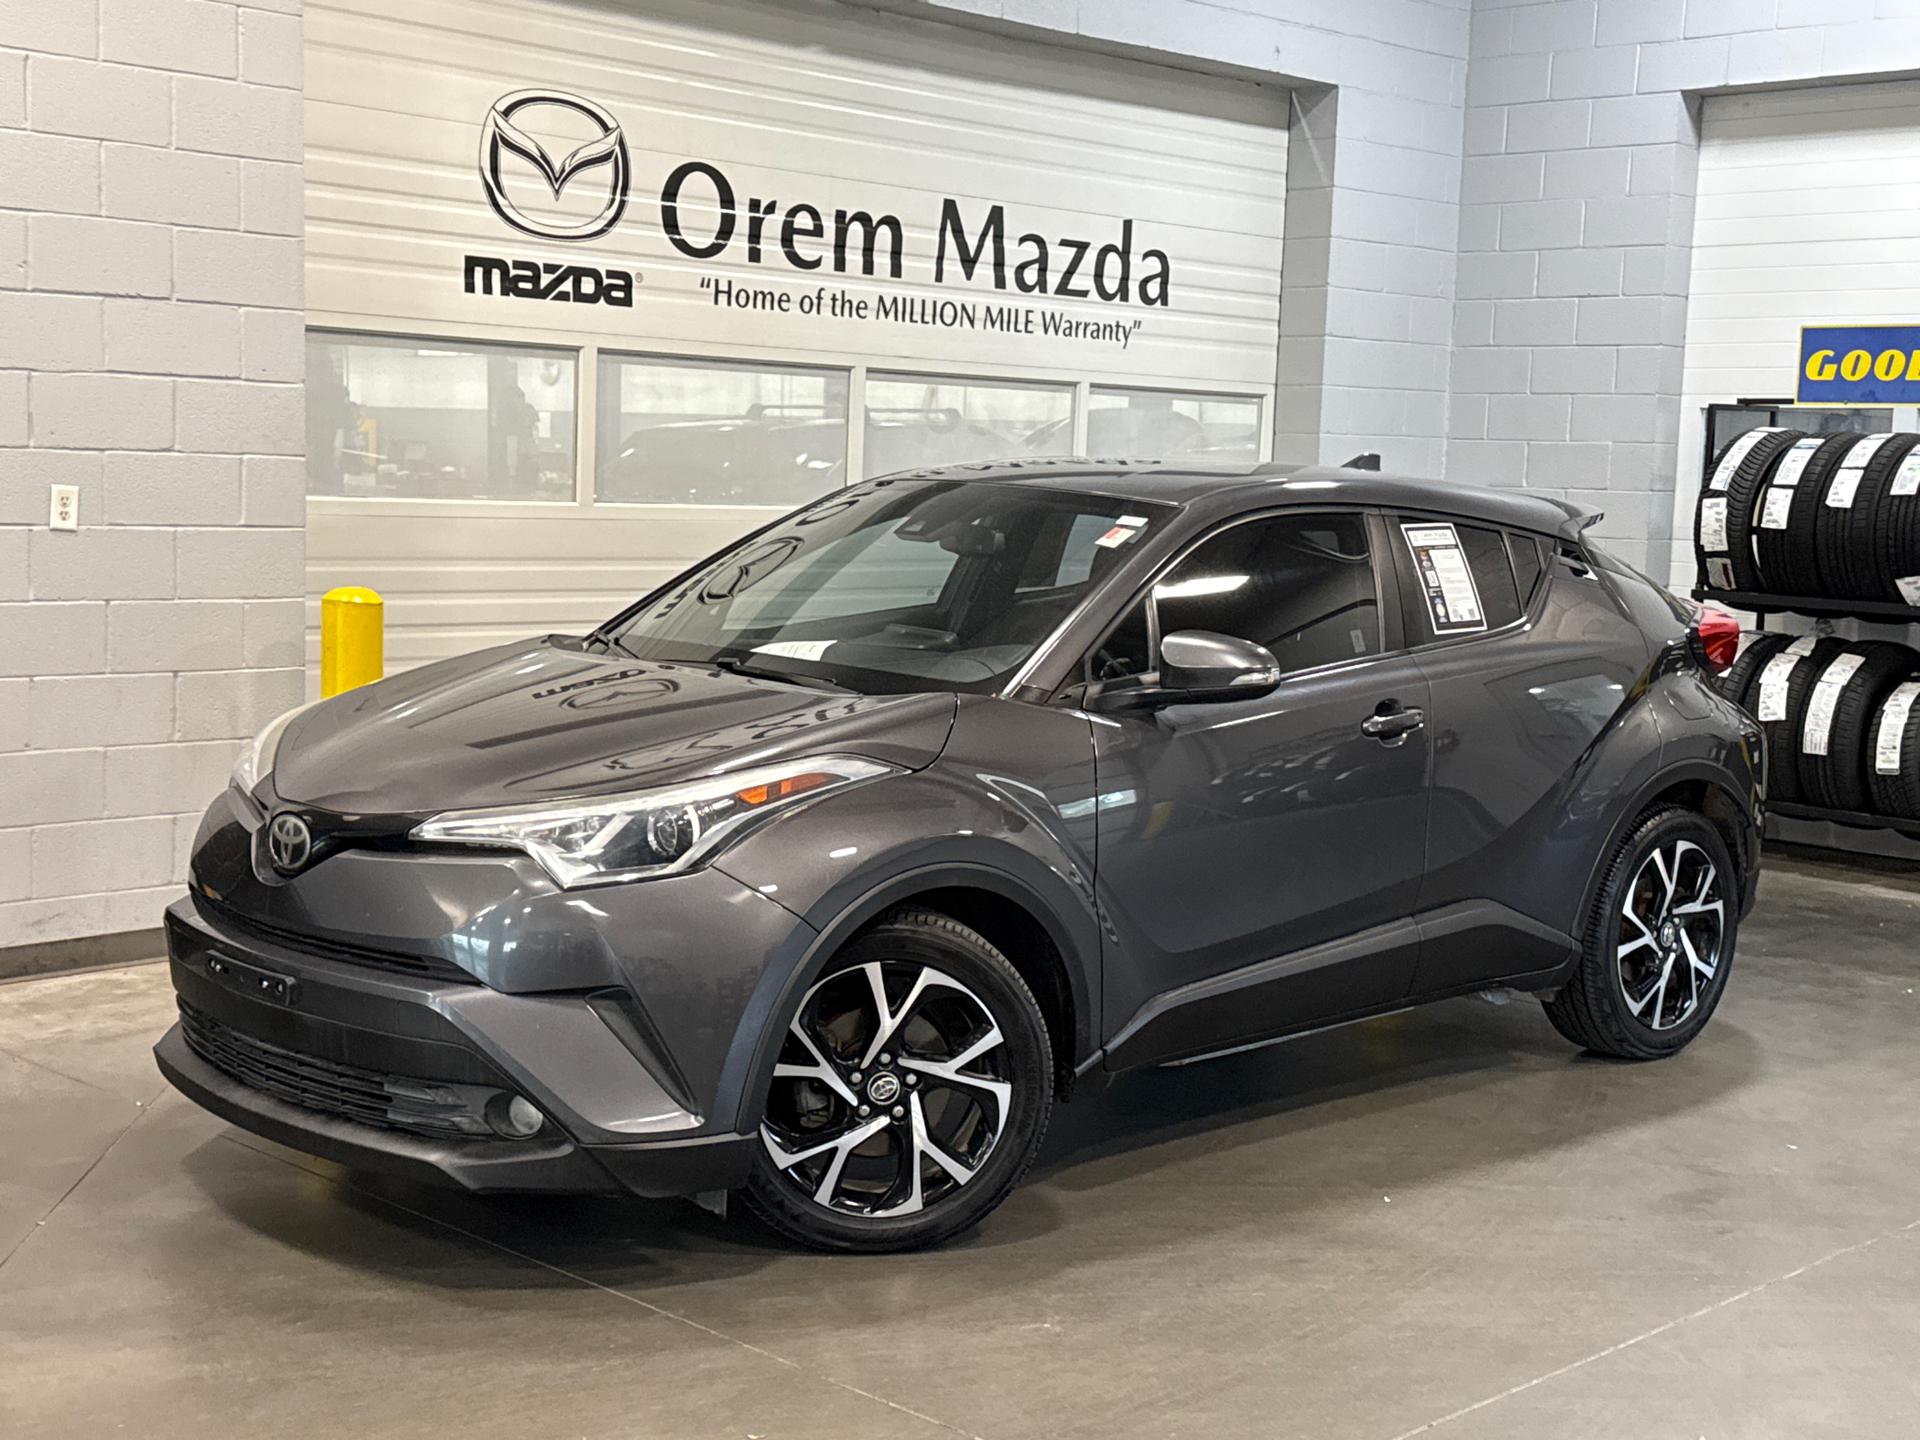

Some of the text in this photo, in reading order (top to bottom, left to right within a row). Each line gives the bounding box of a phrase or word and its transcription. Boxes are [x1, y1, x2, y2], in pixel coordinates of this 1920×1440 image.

[661, 161, 1170, 307] Orem Mazda
[700, 277, 1142, 349] “Home of the MILLION MILE Warranty”
